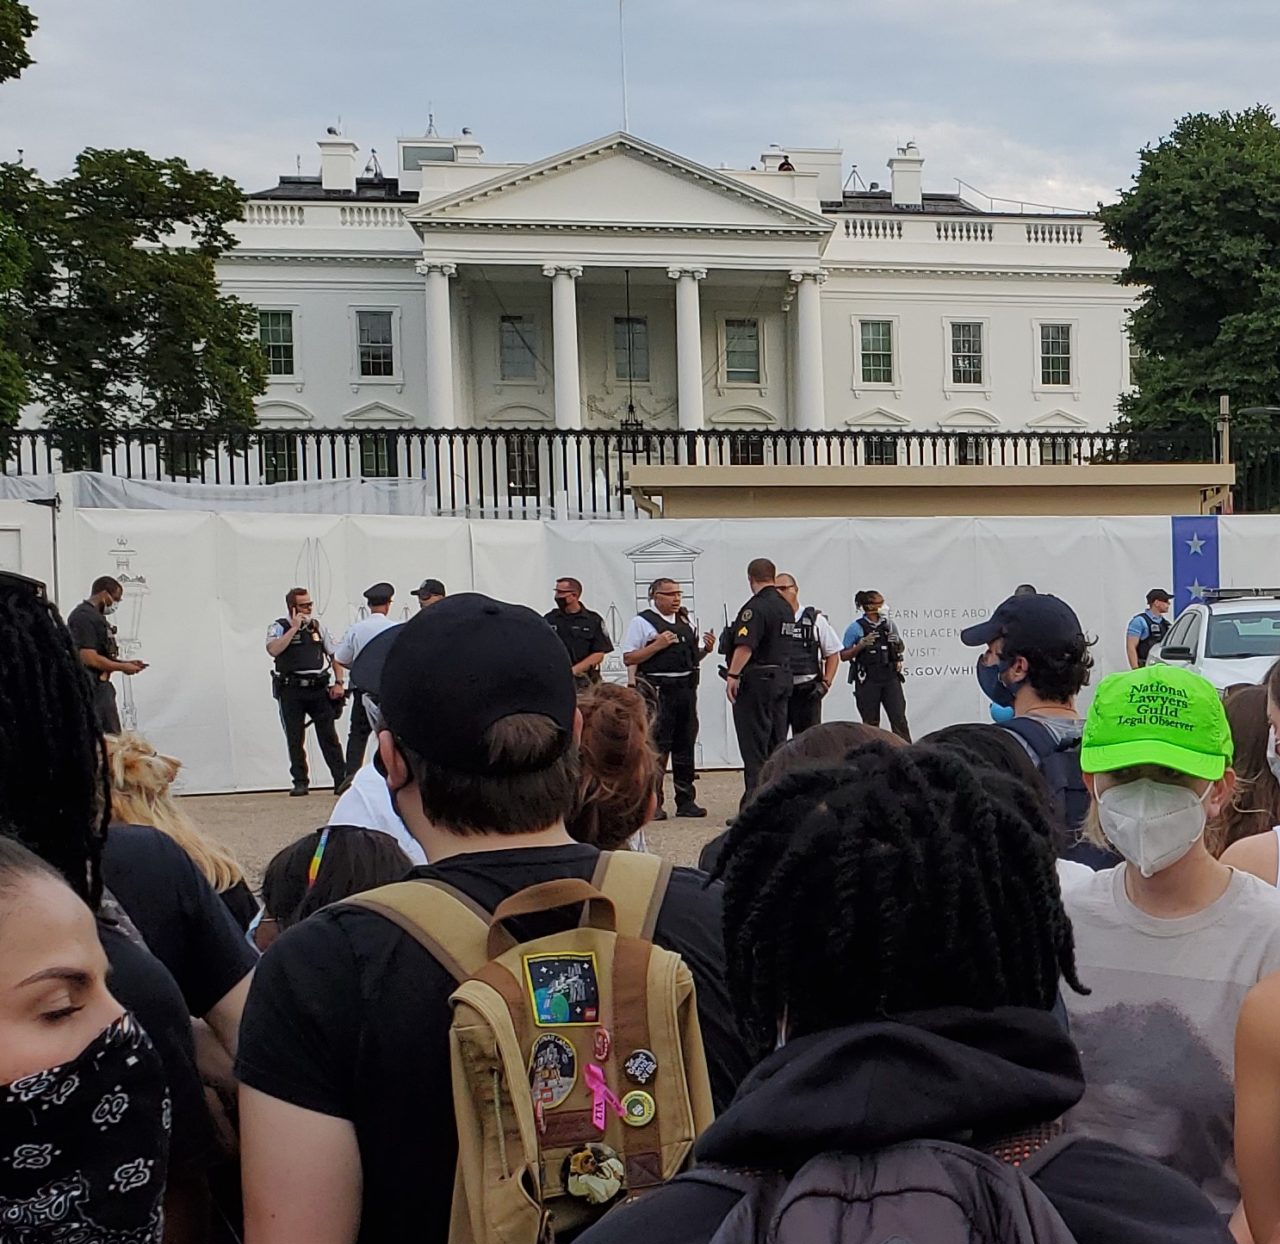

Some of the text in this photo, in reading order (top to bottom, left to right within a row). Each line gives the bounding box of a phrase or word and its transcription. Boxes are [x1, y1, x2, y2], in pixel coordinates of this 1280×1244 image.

[886, 608, 918, 619] EARN
[923, 608, 957, 619] MORE
[903, 664, 975, 677] S.GOV/WHI
[1130, 681, 1188, 698] National
[1128, 693, 1188, 709] Lawyers
[1136, 704, 1178, 718] Guild
[1117, 715, 1195, 732] Legal Observer
